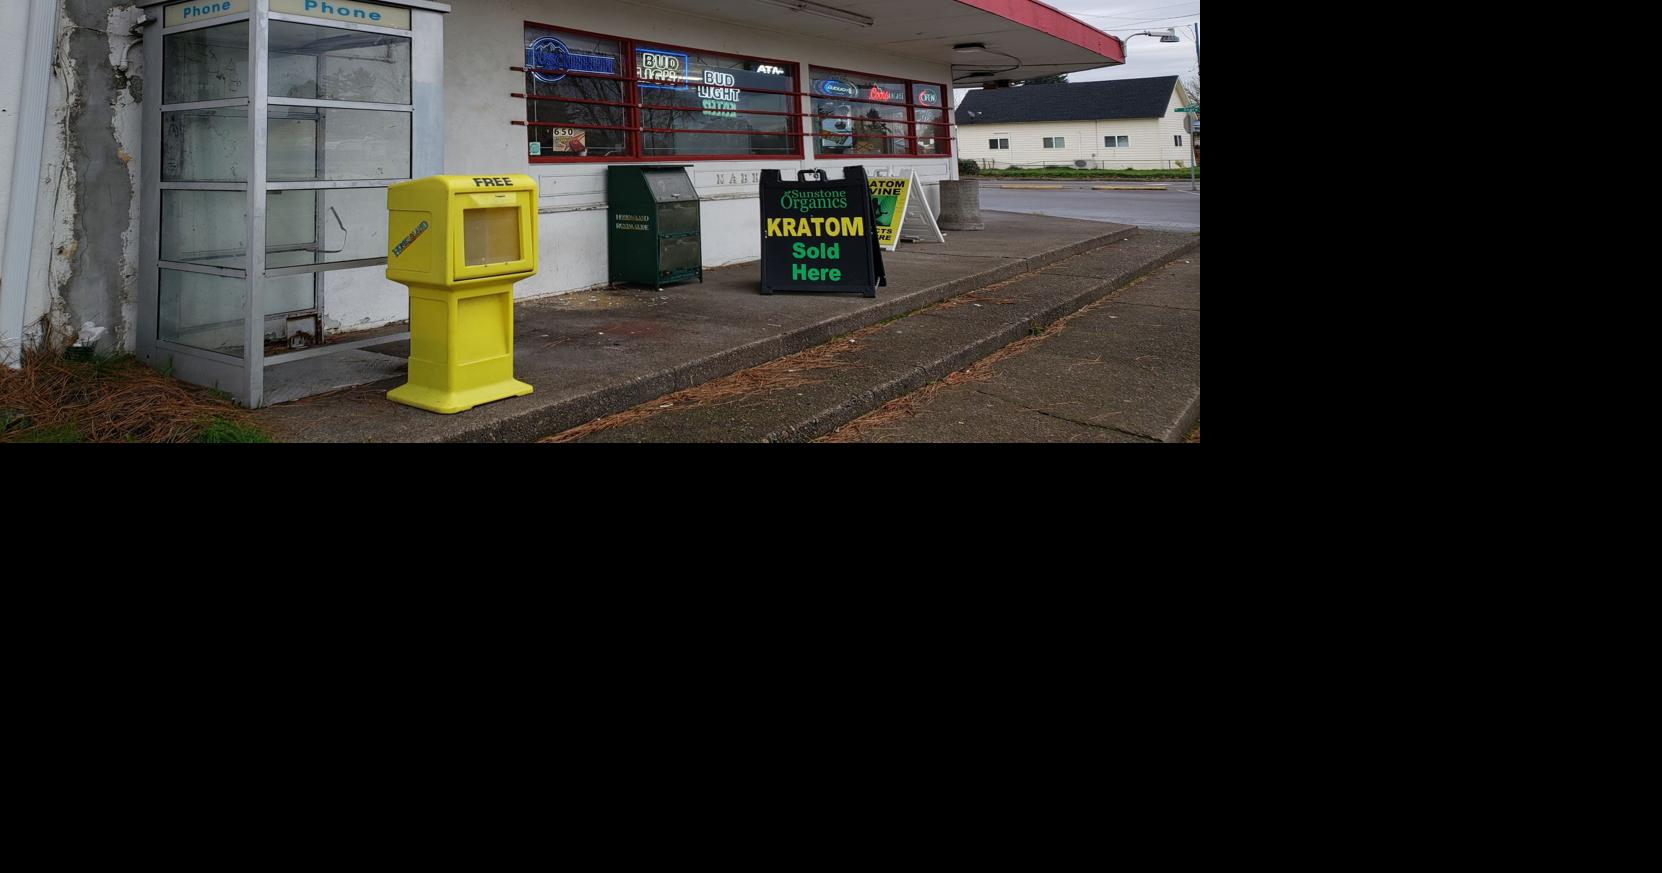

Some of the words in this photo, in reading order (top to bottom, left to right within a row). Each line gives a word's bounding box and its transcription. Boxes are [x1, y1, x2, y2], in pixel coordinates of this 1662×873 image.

[183, 1, 231, 19] Phone
[304, 0, 382, 21] Phone
[643, 53, 679, 70] BUD
[704, 70, 735, 87] BUD
[698, 85, 741, 102] LIGHT
[472, 177, 513, 187] FREE
[870, 180, 905, 188] ATOM
[791, 189, 847, 199] Sunstone
[780, 195, 848, 212] Organics
[767, 217, 864, 237] KRATOM
[792, 242, 840, 259] Sold
[792, 263, 842, 281] Here
